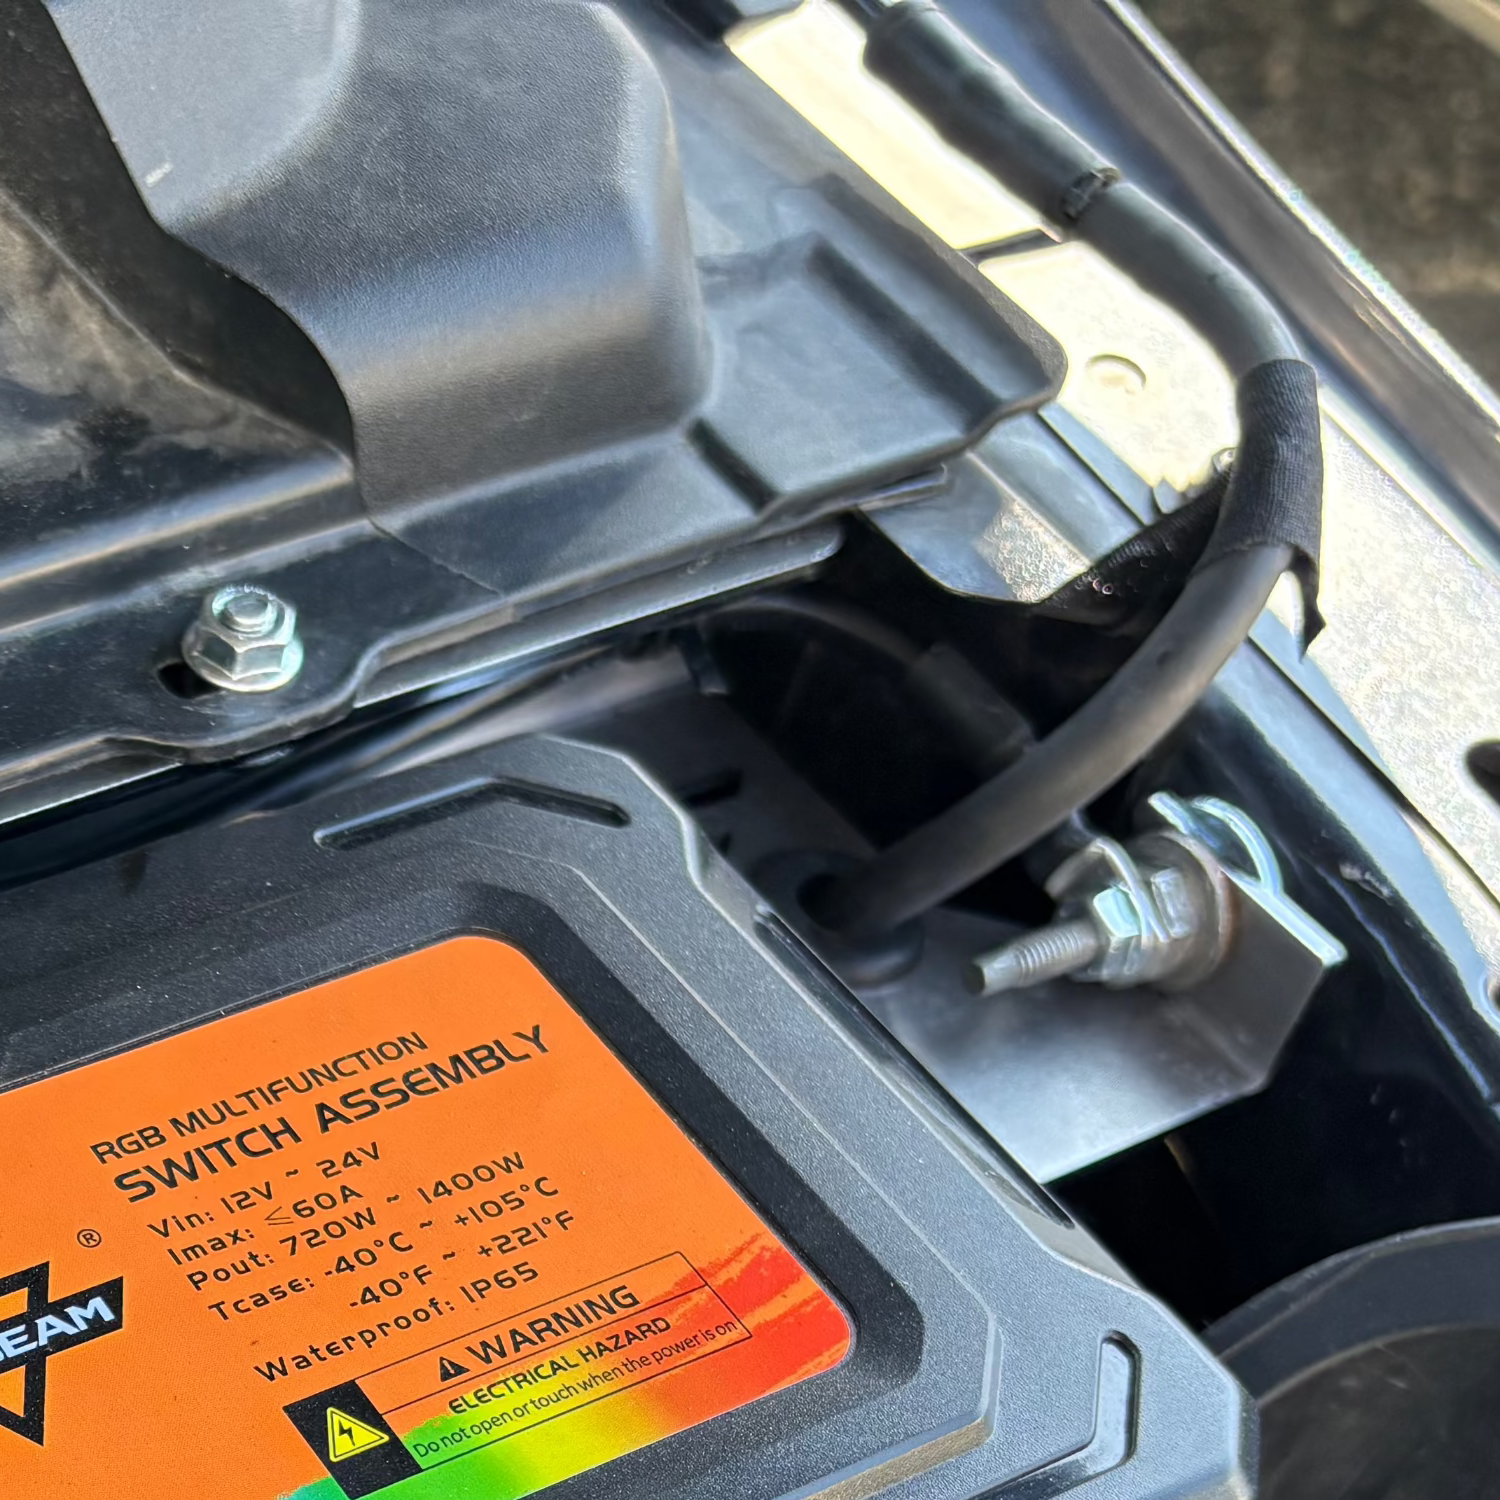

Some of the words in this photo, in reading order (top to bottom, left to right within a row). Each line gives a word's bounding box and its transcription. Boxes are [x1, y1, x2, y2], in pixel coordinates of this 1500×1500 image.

[89, 1125, 167, 1164] RGB
[169, 1031, 428, 1137] MULTIFUNCTION
[113, 1116, 303, 1203] SWITCH
[313, 1024, 550, 1134] ASSEMBLY
[147, 1209, 215, 1239] Vin:
[220, 1180, 274, 1214] 12V
[316, 1141, 382, 1178] 24V
[166, 1226, 255, 1266] Imax:
[186, 1253, 275, 1291] Pout:
[279, 1207, 378, 1257] 720W
[417, 1151, 526, 1205] 1400W
[208, 1275, 315, 1323] Tcase:
[325, 1231, 414, 1278] -40°C
[454, 1175, 560, 1229] +105°C
[349, 1264, 434, 1310] -40°F
[476, 1211, 575, 1259] +221°F
[253, 1297, 455, 1383] Waterproof:
[459, 1261, 539, 1304] IP65
[449, 1355, 580, 1415] ELECTRICAL
[576, 1317, 672, 1363] HAZARD
[465, 1285, 641, 1367] WARNING
[412, 1441, 440, 1458] Do
[440, 1426, 471, 1448] not
[470, 1411, 513, 1435] open
[512, 1402, 531, 1418] or
[530, 1383, 580, 1411] touch
[577, 1367, 625, 1391] when
[621, 1357, 652, 1373] the
[651, 1336, 700, 1365] power
[698, 1329, 716, 1342] is
[715, 1320, 738, 1336] on
